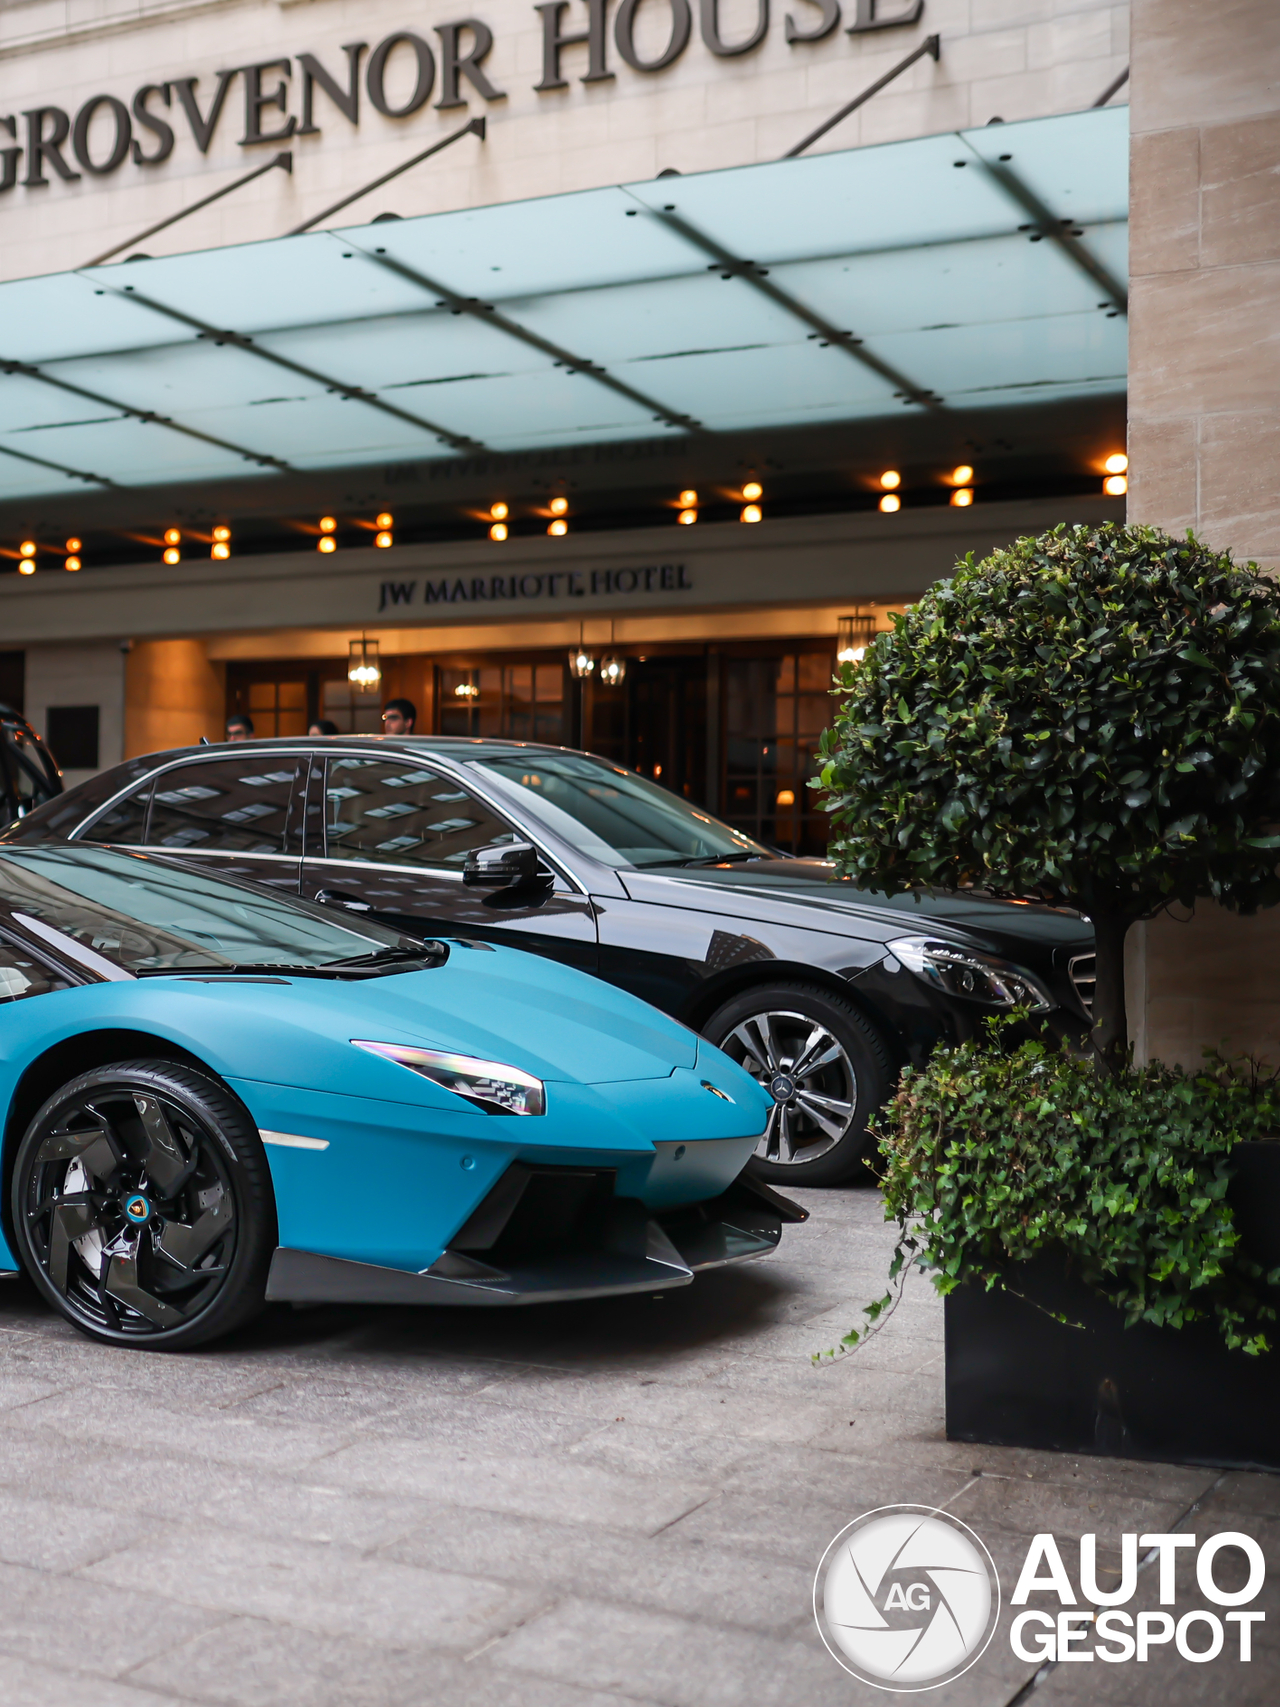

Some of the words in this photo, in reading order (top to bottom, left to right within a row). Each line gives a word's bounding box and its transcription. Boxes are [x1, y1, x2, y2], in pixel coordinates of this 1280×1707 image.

[377, 580, 417, 613] JW
[424, 571, 582, 604] MARRIOTT
[590, 563, 693, 596] HOTEL
